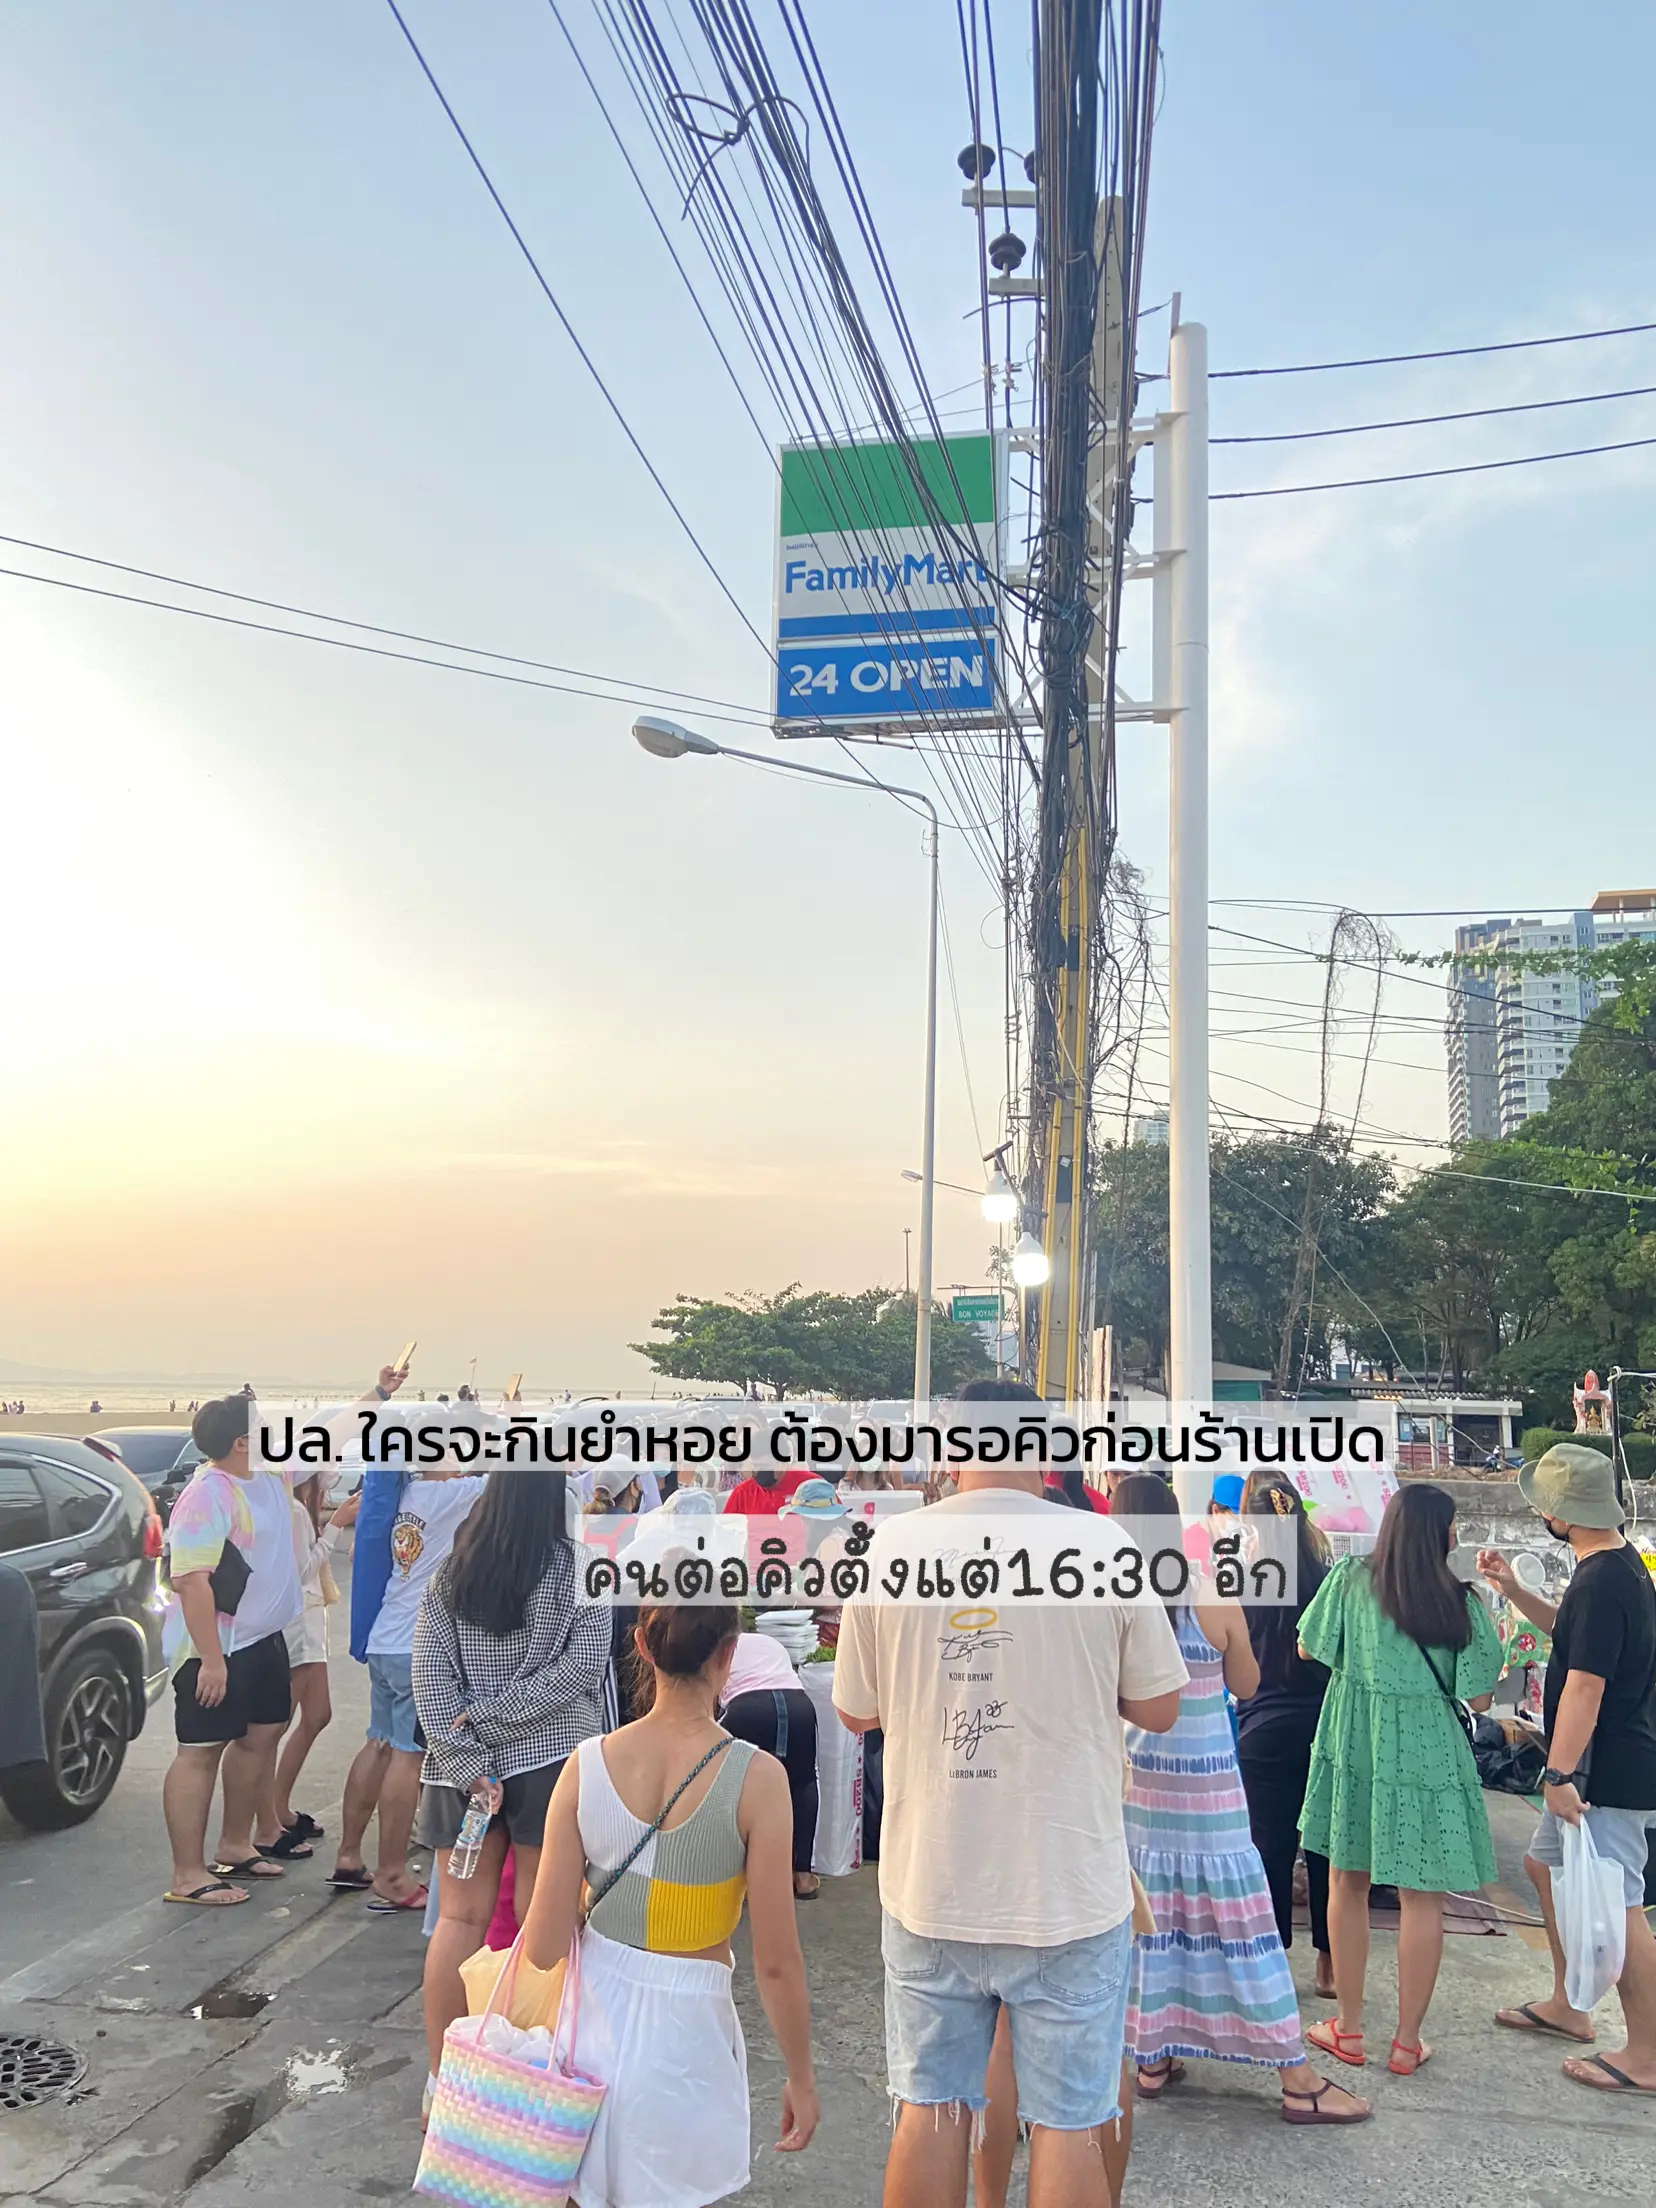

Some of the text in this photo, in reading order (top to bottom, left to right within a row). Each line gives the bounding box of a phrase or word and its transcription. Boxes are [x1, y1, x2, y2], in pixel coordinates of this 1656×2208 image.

[785, 552, 990, 595] FamilyMart
[789, 654, 984, 697] 24 OPEN
[948, 1672, 993, 1682] KOBE BRYANT
[976, 1769, 998, 1779] JAMES
